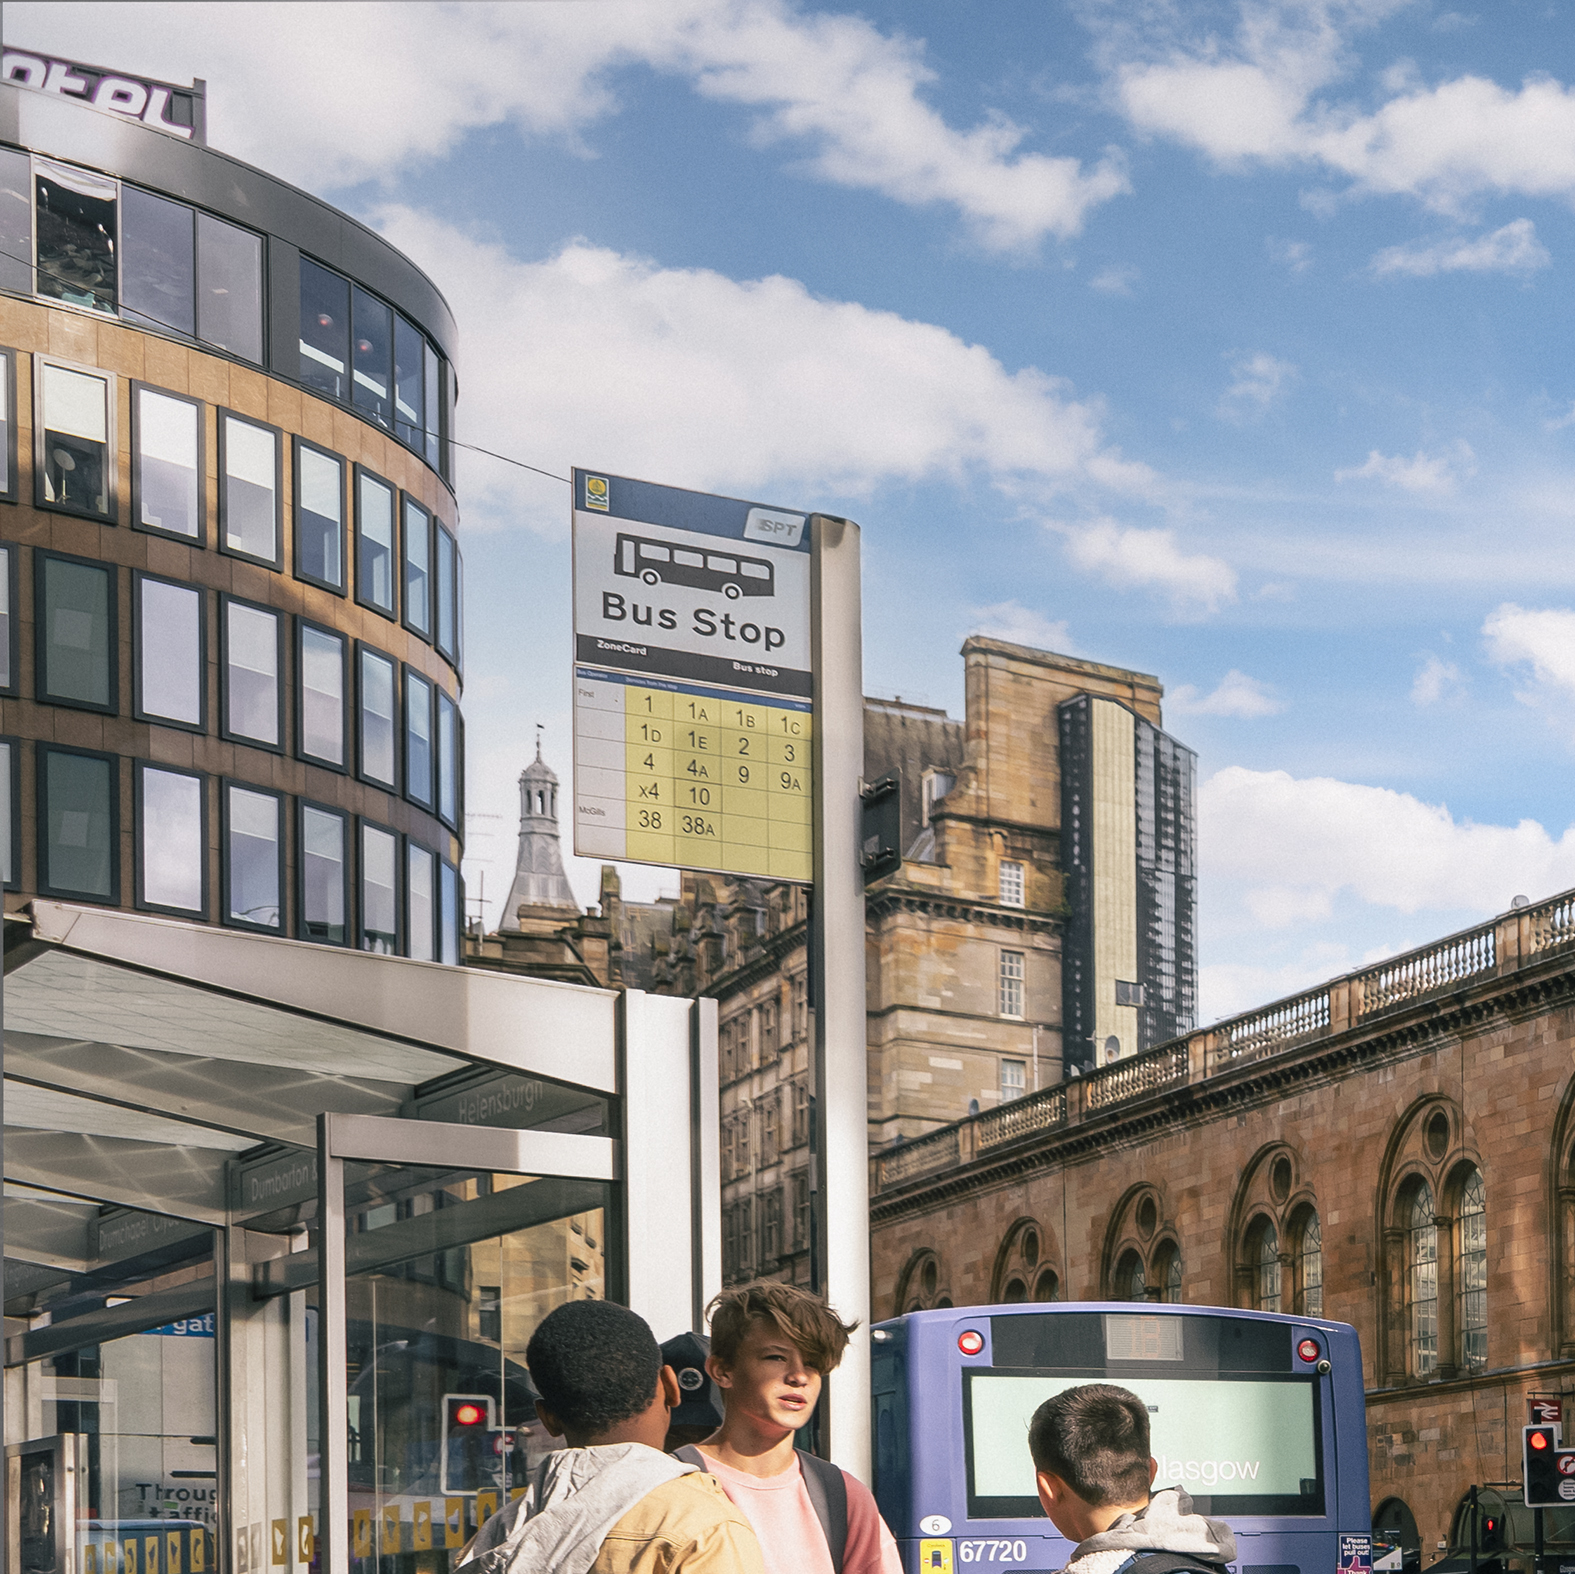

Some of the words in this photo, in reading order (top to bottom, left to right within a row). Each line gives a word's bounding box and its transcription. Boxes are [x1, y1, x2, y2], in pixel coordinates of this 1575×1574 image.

[602, 590, 677, 630] Bus
[692, 607, 786, 652] Stop
[597, 639, 647, 657] ZoneCard
[733, 661, 753, 673] Bus
[756, 665, 779, 678] stop
[578, 689, 595, 698] First
[644, 696, 652, 712] 1
[688, 702, 709, 722] 1A
[736, 709, 756, 728] 1B
[780, 716, 801, 735] 1C
[641, 723, 662, 743] 1D
[688, 730, 708, 750] 1E
[738, 738, 750, 756] 2
[784, 744, 796, 763] 3
[643, 752, 655, 770] 4
[687, 759, 709, 778] 4A
[738, 766, 750, 784] 9
[780, 772, 802, 792] 9A
[688, 787, 711, 806] 10
[638, 810, 662, 829] 38
[682, 815, 715, 837] 38A
[251, 1163, 309, 1203] Dumbarton
[1157, 1455, 1260, 1487] lasgow
[931, 1519, 940, 1532] 6
[959, 1540, 1027, 1562] 67720
